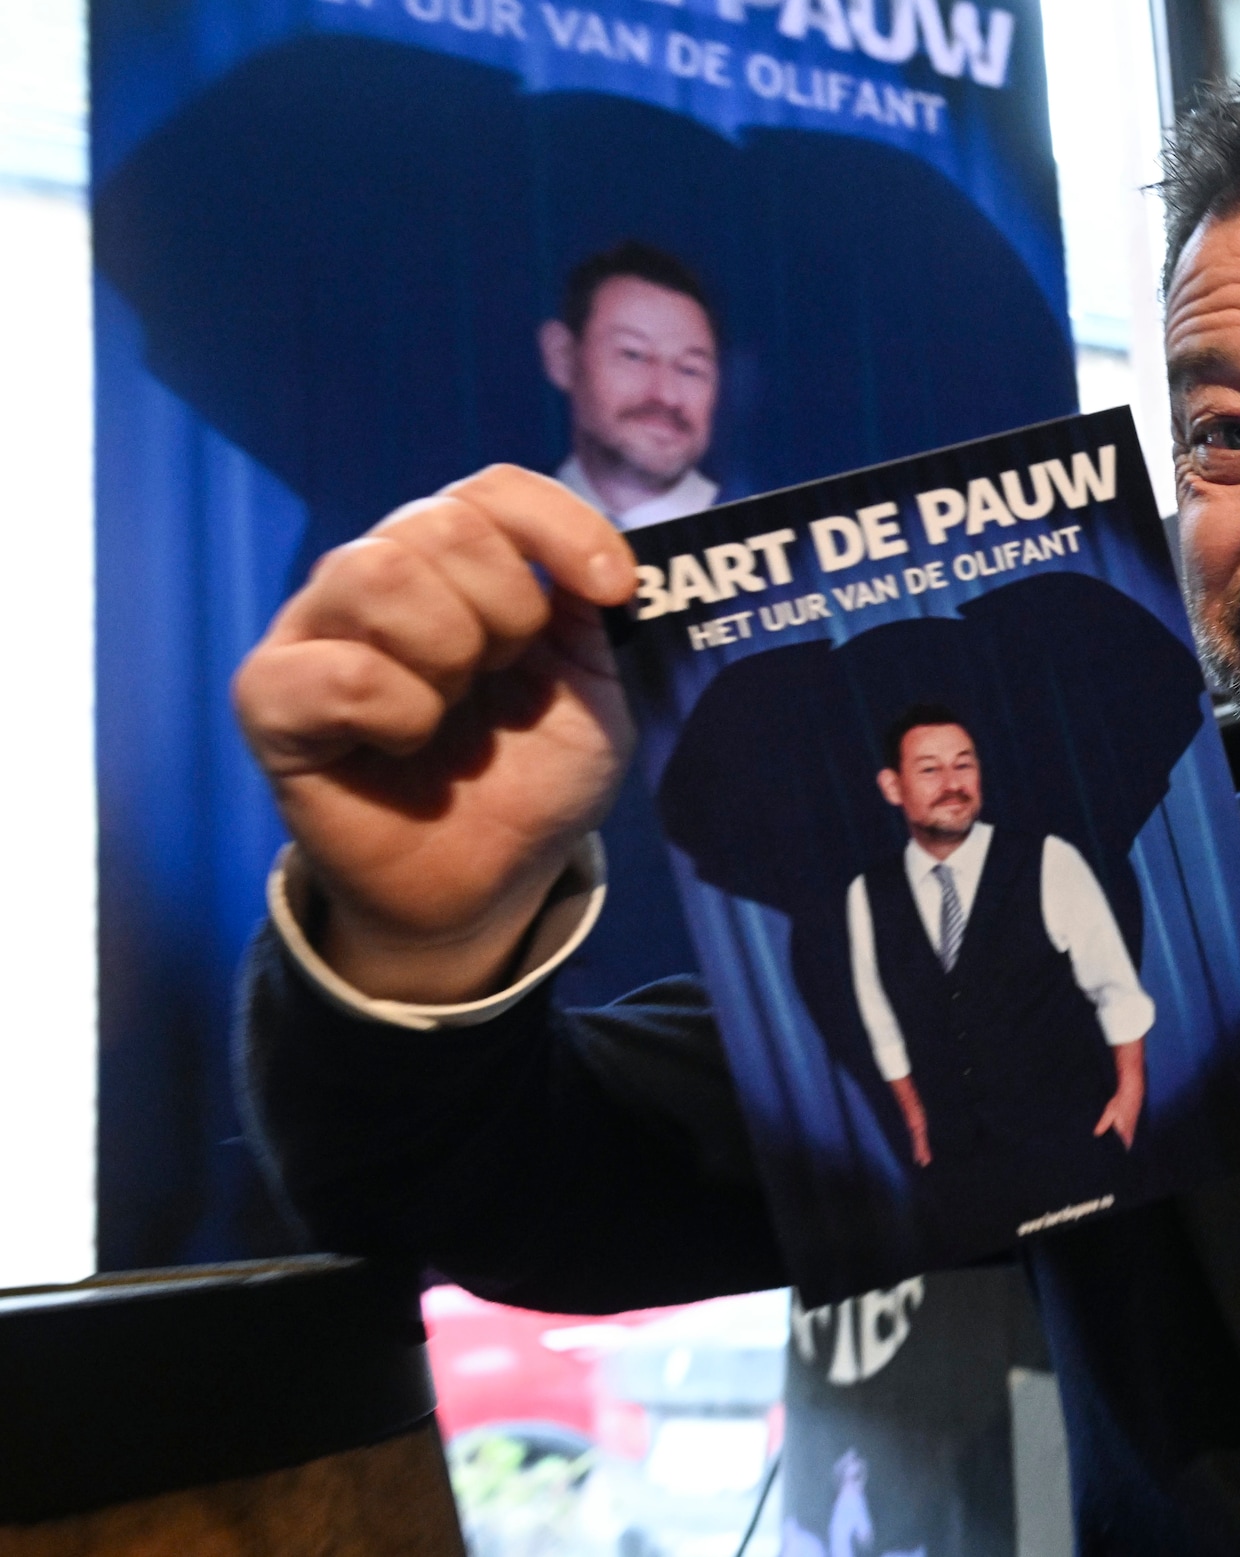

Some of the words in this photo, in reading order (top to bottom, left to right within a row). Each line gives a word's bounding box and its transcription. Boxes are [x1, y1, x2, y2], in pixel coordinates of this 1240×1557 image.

[541, 3, 650, 66] VAN
[665, 31, 732, 88] DE
[744, 53, 947, 135] OLIFANT
[808, 502, 909, 573] DE
[915, 444, 1117, 546] PAUW
[686, 611, 754, 651] HET
[759, 592, 832, 632] UUR
[832, 574, 900, 613] VAN
[903, 561, 949, 596] DE
[952, 525, 1082, 582] OLIFANT
